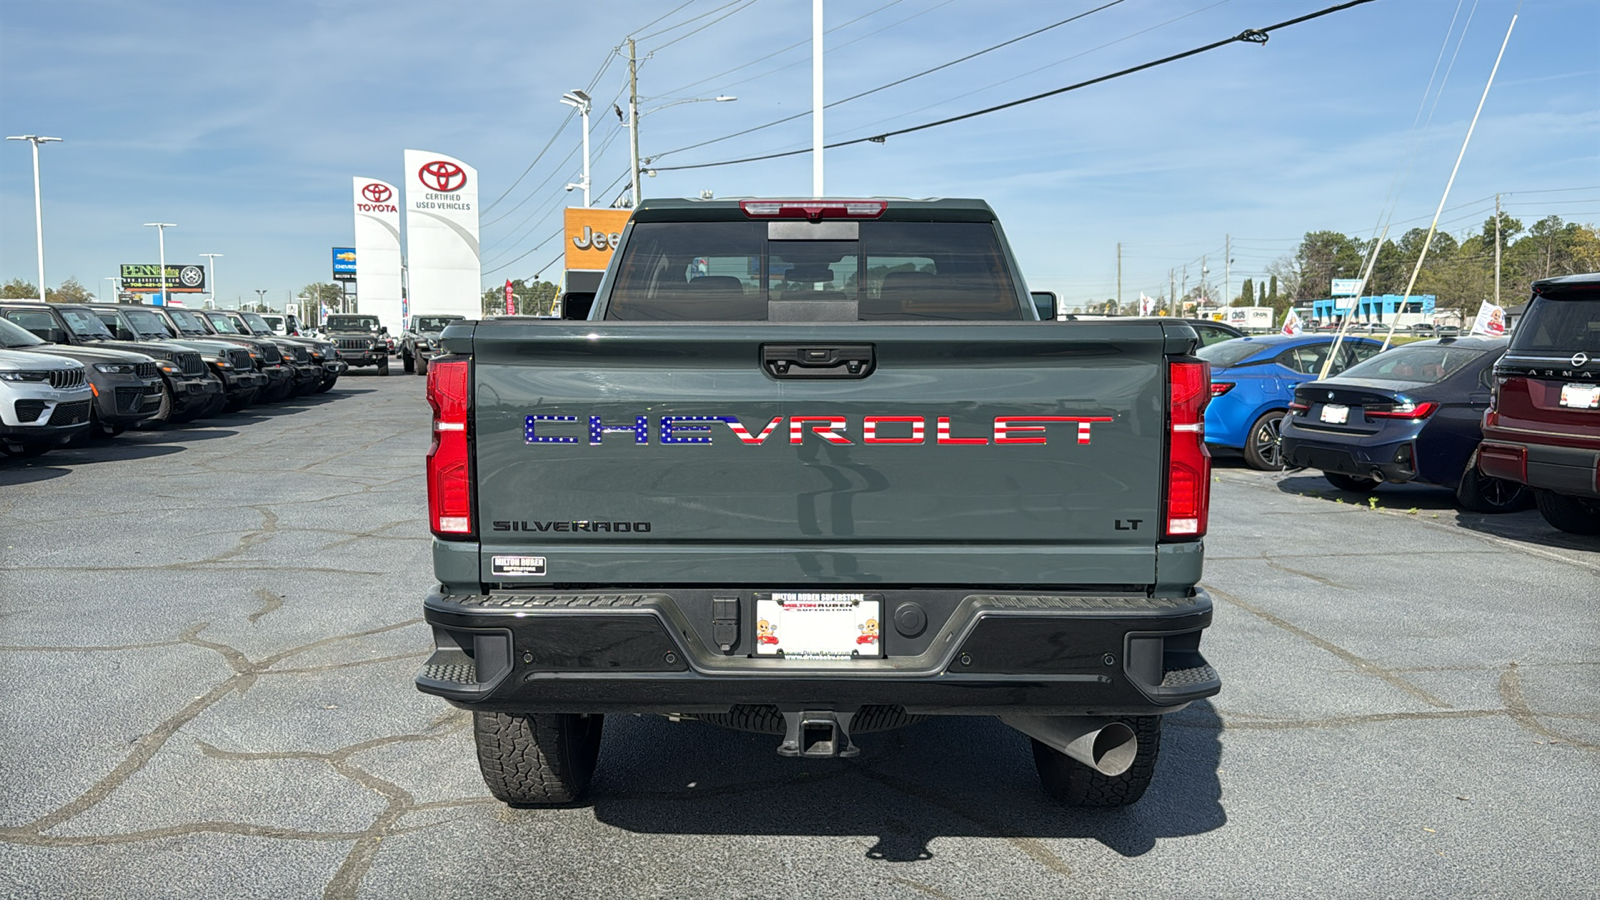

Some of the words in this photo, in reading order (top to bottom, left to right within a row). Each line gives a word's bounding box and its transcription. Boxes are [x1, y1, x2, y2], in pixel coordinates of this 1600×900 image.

[425, 193, 461, 201] CERTIFIED
[357, 204, 398, 213] TOYOTA
[437, 202, 470, 210] VEHICLES
[525, 415, 1113, 445] CHEVROLET
[493, 520, 651, 533] SILVERADO
[1115, 519, 1143, 530] LT
[495, 557, 520, 566] MILTON
[521, 558, 543, 567] RUBEN
[772, 593, 796, 601] MILTON
[798, 593, 820, 601] RUBEN
[821, 593, 864, 601] SUPERSTORE
